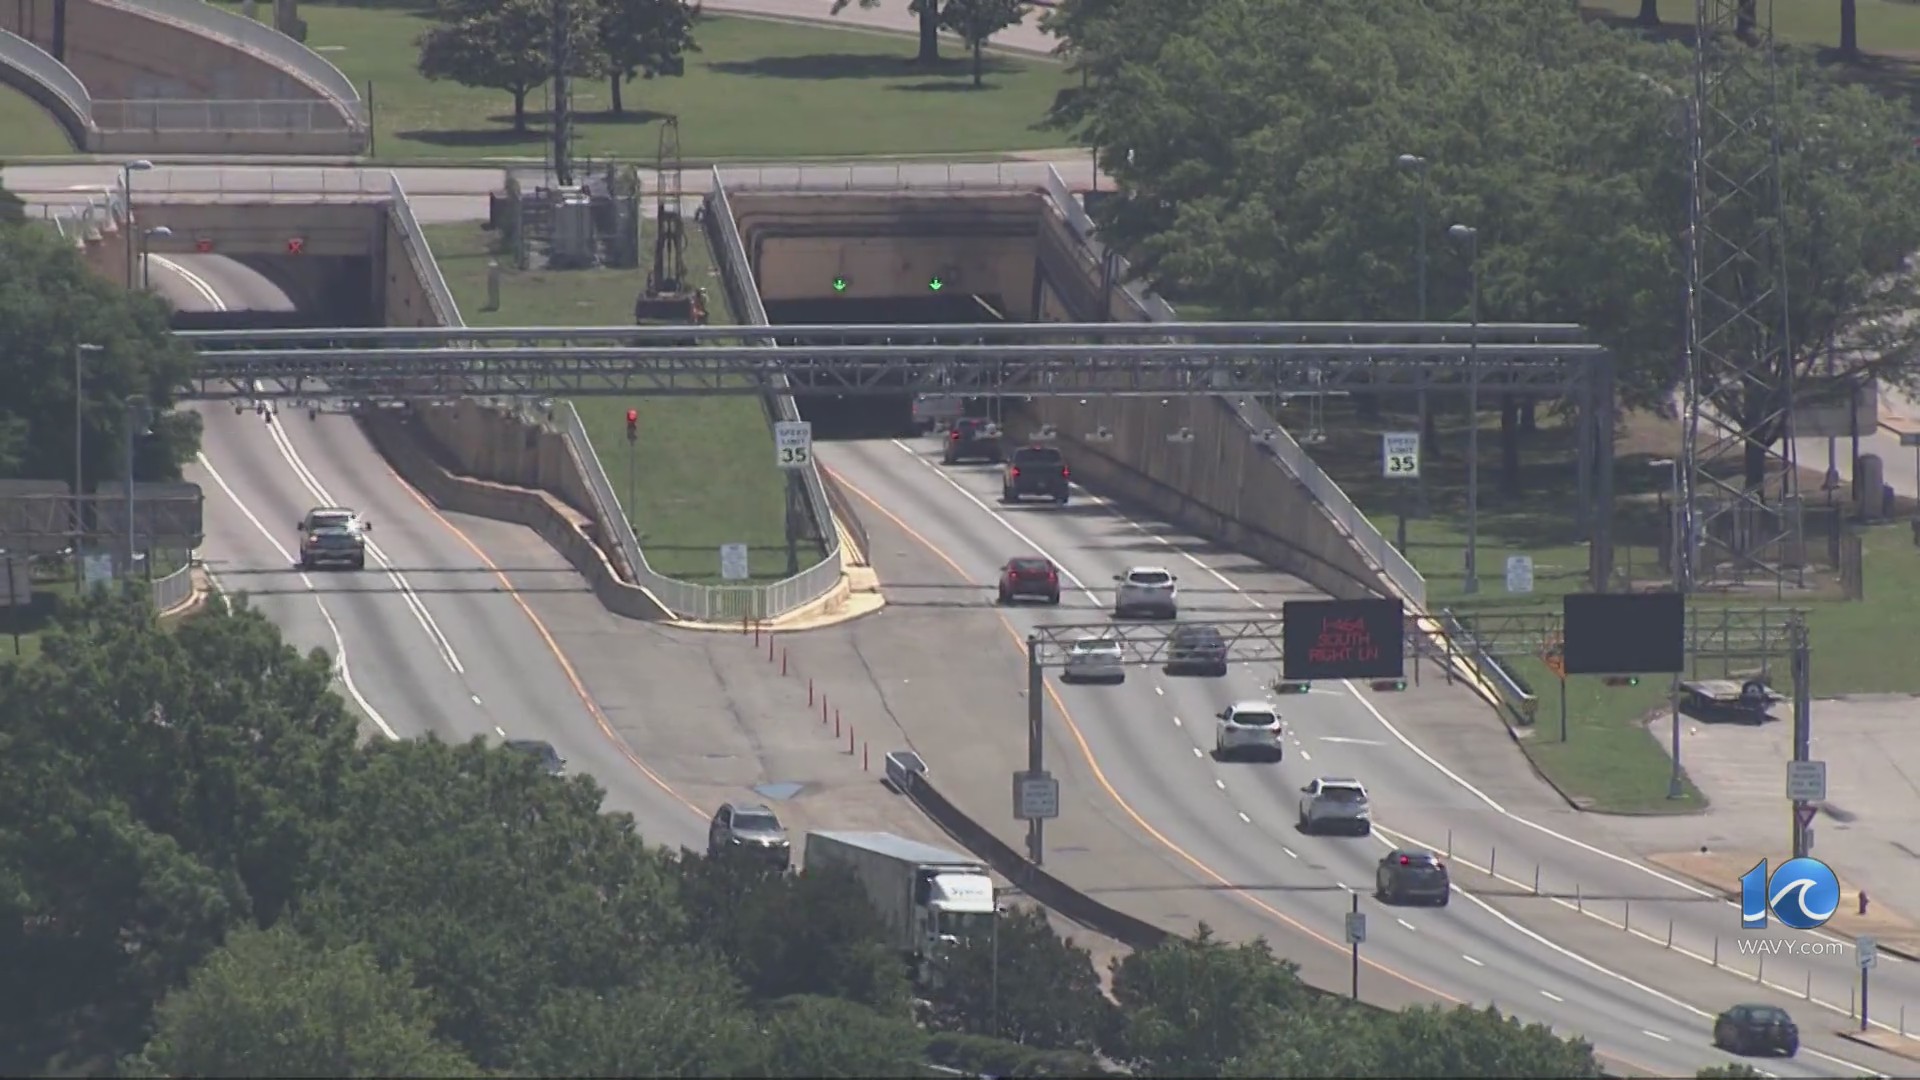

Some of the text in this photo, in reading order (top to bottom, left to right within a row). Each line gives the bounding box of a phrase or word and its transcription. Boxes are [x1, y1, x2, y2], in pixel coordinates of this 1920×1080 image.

[779, 429, 808, 437] SPEED
[782, 447, 806, 462] 35
[1391, 456, 1414, 471] 35
[1319, 633, 1370, 647] SOUTH
[1308, 648, 1350, 662] RIGHT
[1358, 647, 1378, 661] LN
